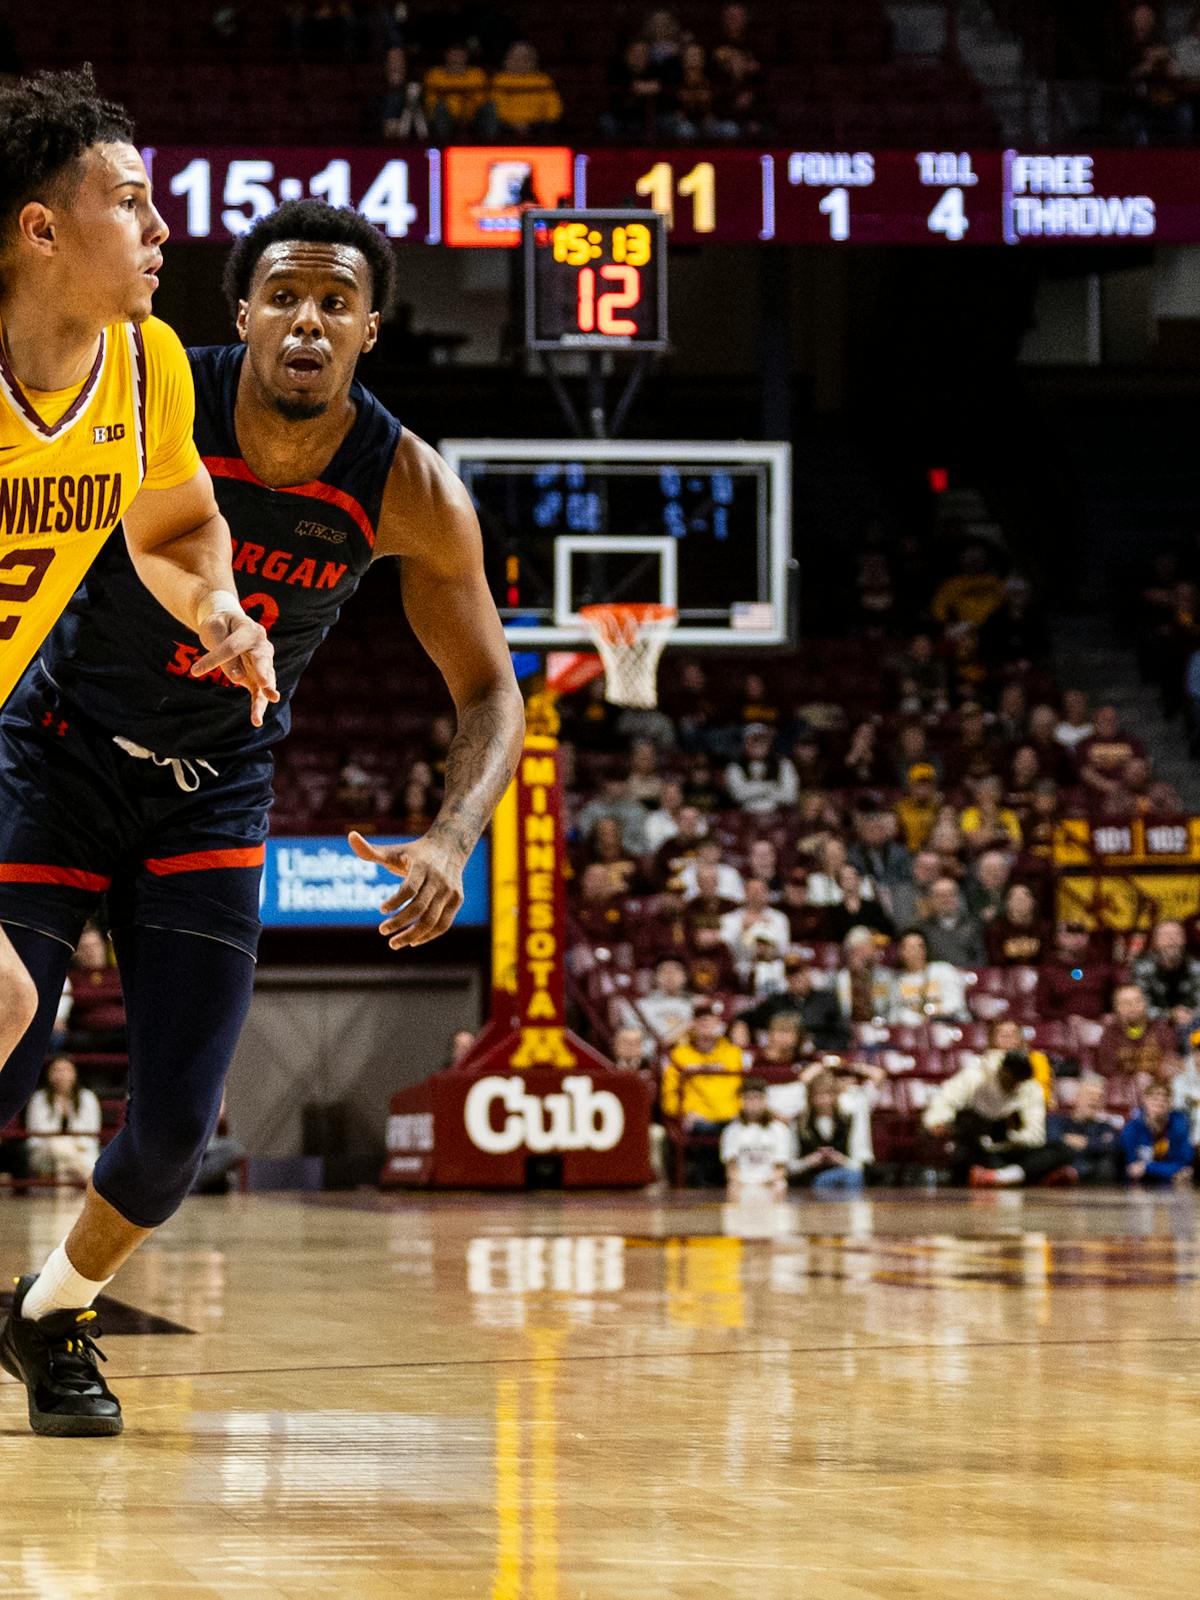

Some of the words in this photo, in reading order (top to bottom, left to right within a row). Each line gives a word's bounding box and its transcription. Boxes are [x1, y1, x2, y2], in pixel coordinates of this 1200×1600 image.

[788, 151, 875, 186] FOULS
[1012, 155, 1095, 194] FREE
[635, 161, 716, 234] 11
[818, 187, 850, 241] 1
[927, 187, 969, 241] 4
[1012, 196, 1157, 236] THROWS
[576, 264, 641, 337] 12
[294, 520, 348, 544] MEAC
[231, 537, 348, 590] RGAN
[276, 846, 379, 880] United
[520, 756, 558, 1020] MINNESOTA
[464, 1075, 625, 1154] Cub
